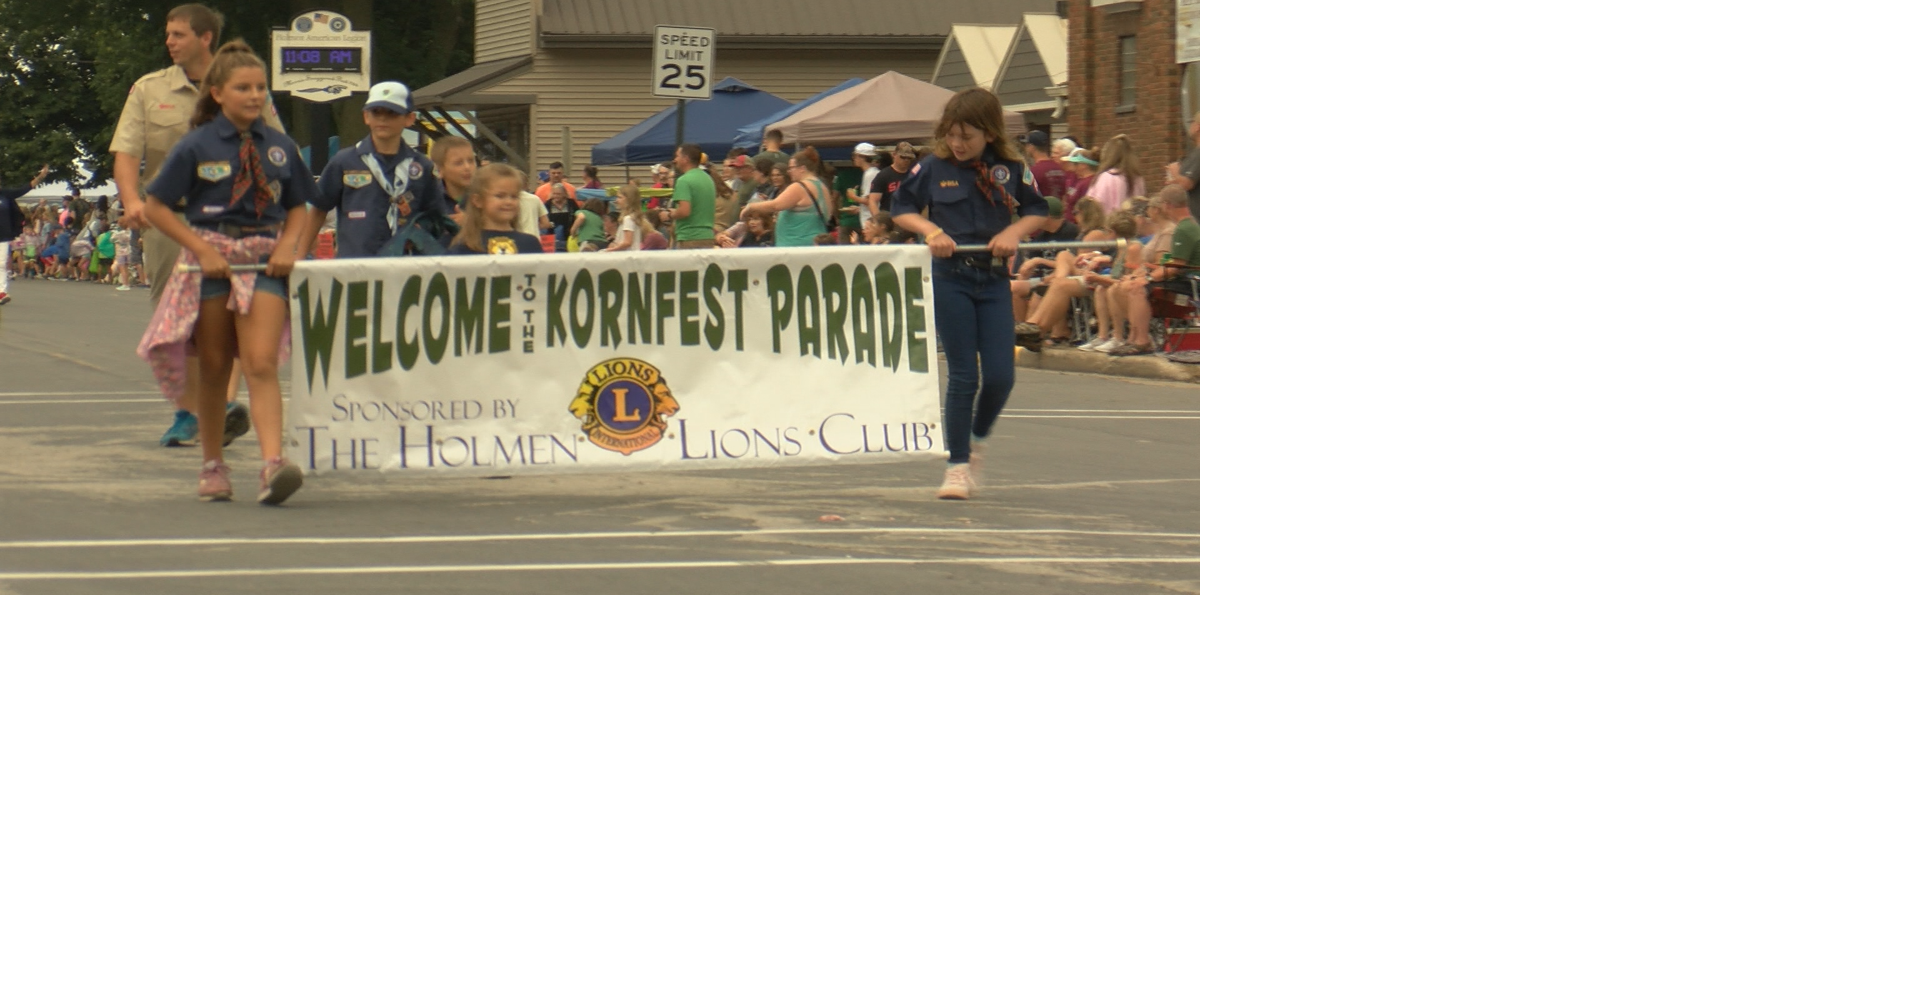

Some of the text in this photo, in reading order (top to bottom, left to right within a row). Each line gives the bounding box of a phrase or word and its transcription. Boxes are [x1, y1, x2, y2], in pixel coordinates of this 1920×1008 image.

[660, 34, 710, 48] SPEED
[664, 49, 704, 61] LIMIT
[285, 50, 352, 63] 11:08 AM
[660, 63, 706, 91] 25
[523, 273, 536, 301] TO
[523, 309, 535, 353] THE
[546, 261, 930, 374] KORNFEST PARADE
[297, 272, 512, 396] WELCOME
[592, 361, 654, 382] LIONS
[331, 394, 521, 423] SPONSORED BY
[611, 388, 642, 422] L
[295, 424, 578, 471] THE HOLMEN
[678, 412, 934, 460] LIONS CLUB
